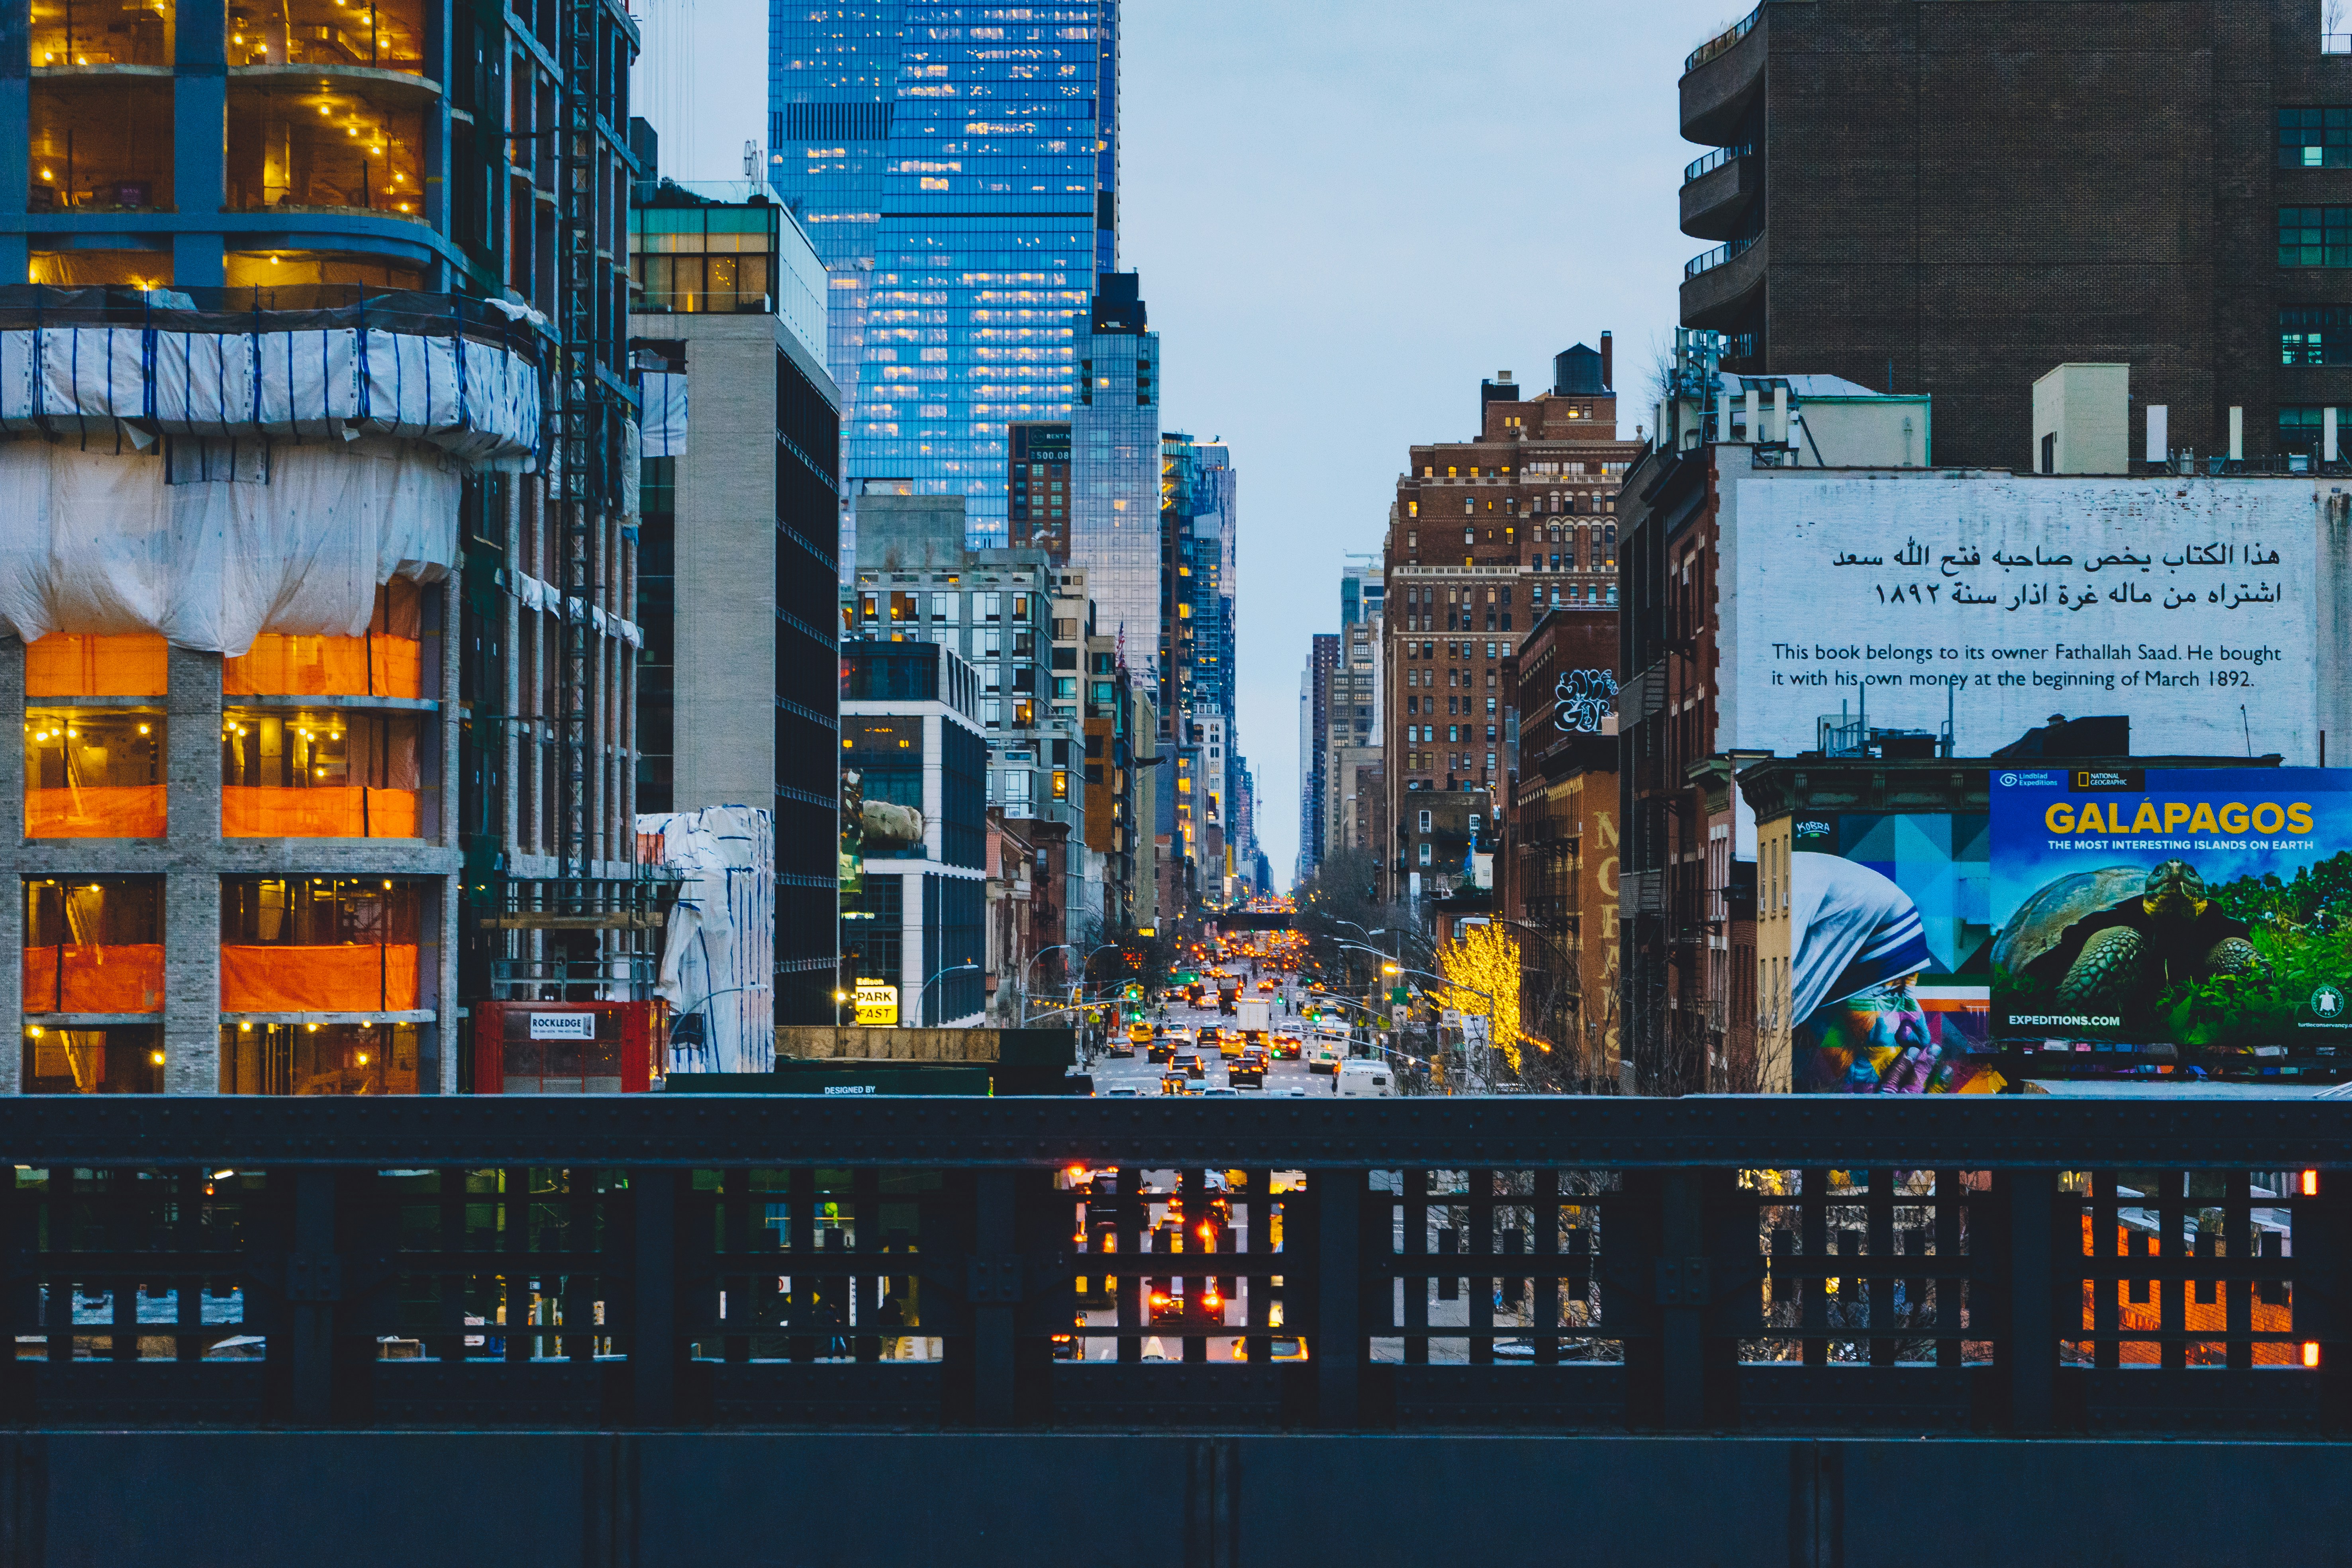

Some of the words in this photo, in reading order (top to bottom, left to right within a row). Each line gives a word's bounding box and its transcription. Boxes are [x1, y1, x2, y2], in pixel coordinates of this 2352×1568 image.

[1833, 551, 1883, 566] سعد
[1941, 545, 1980, 577] فتح
[1992, 545, 2073, 573] صاحبه
[2084, 546, 2151, 572] يخص
[2162, 542, 2233, 574] الكتاب
[2244, 543, 2280, 565] هذا
[1876, 583, 1940, 605] ١٨٩٢
[1952, 581, 1997, 604] سنة
[2005, 583, 2047, 612] اذار
[2058, 584, 2098, 612] غرة
[2109, 581, 2152, 603] ماله
[2163, 587, 2196, 610] من
[2208, 582, 2281, 610] اشتراه
[1772, 643, 1808, 660] This
[1815, 644, 1860, 660] book
[1867, 644, 1933, 664] belongs
[1940, 647, 1958, 659] to
[1966, 645, 1985, 660] its
[1991, 649, 2048, 660] owner
[2056, 643, 2131, 660] Fathallah
[2138, 644, 2181, 660] Saad.
[2188, 645, 2213, 660] He
[2220, 645, 2281, 665] bought
[1772, 670, 1784, 685] it
[1789, 670, 1827, 686] with
[1835, 670, 1858, 686] his
[1865, 674, 1902, 686] own
[1910, 674, 1968, 690] money
[1975, 674, 1991, 686] at
[1997, 670, 2026, 686] the
[2033, 670, 2115, 690] beginning
[2121, 670, 2140, 686] of
[2145, 670, 2199, 686] March
[2209, 671, 2254, 687] 1892.
[1797, 821, 1830, 832] KOBRA
[2045, 797, 2313, 834] GALÁPAGOS
[2048, 841, 2071, 849] THE
[2075, 841, 2108, 849] MOST
[2112, 841, 2191, 849] INTERESTING
[2195, 841, 2246, 849] ISLANDS
[2250, 841, 2268, 849] ON
[2272, 841, 2313, 849] EARTH
[858, 992, 892, 1001] PARK
[858, 1009, 892, 1018] FAST
[2009, 1015, 2120, 1026] EXPEDITIONS.COM
